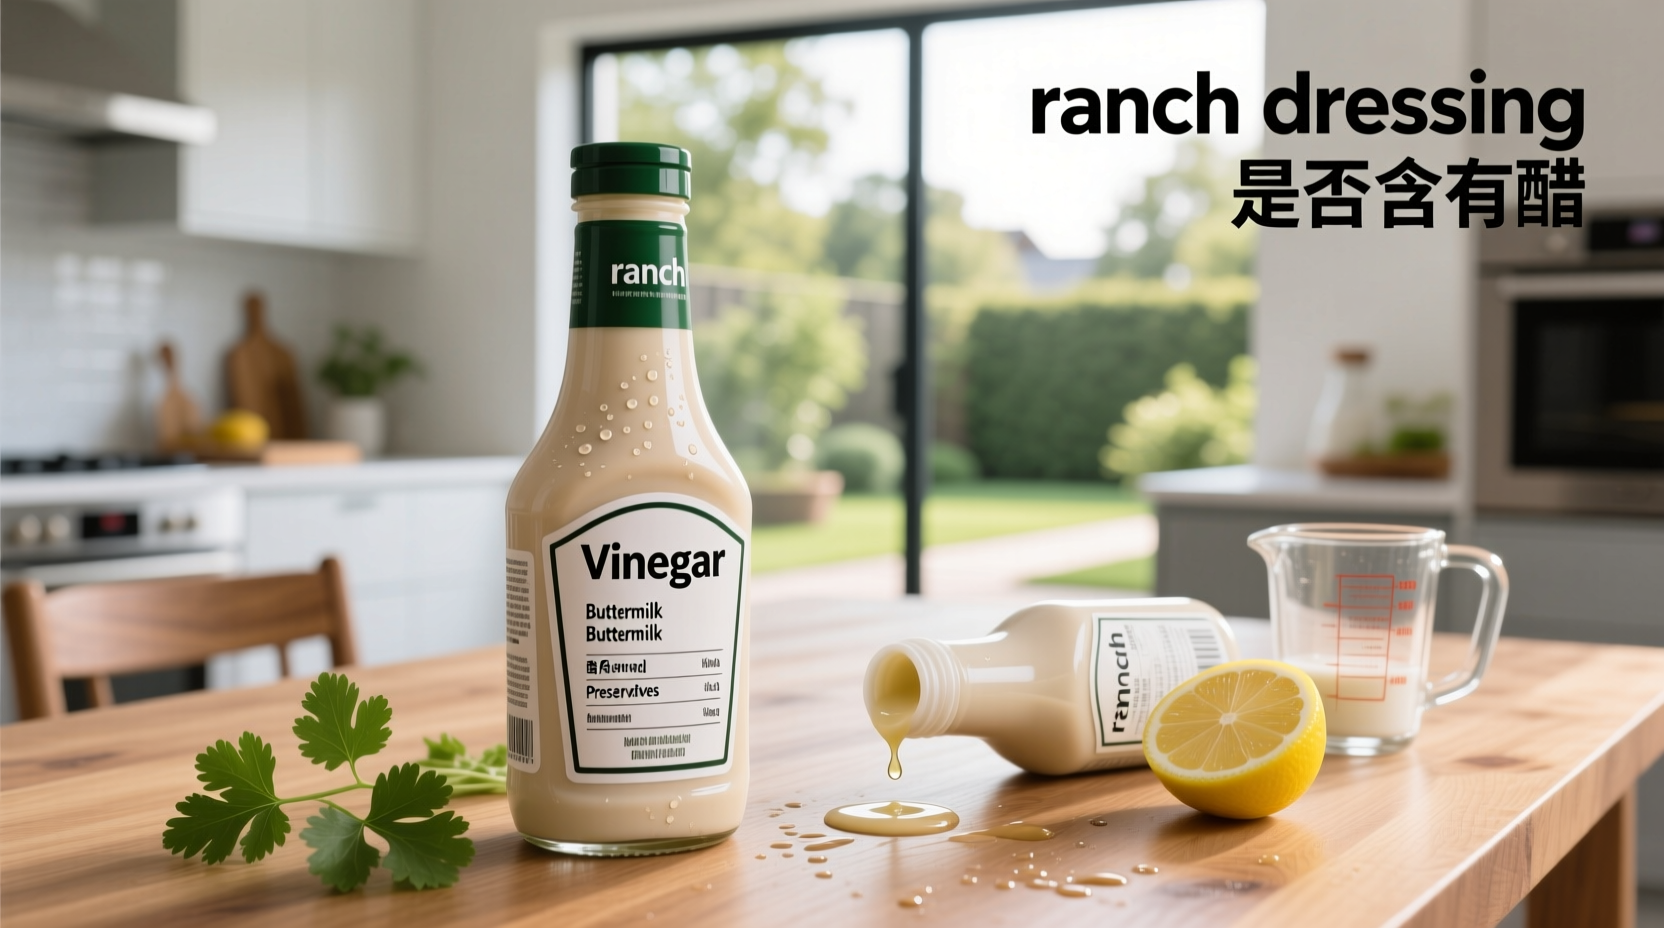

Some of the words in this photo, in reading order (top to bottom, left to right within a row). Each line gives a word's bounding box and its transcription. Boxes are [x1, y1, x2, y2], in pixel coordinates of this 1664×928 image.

[611, 257, 686, 288] ranch
[581, 542, 725, 589] Vinegar
[586, 602, 663, 620] Buttermilk
[586, 624, 663, 642] Buttermilk
